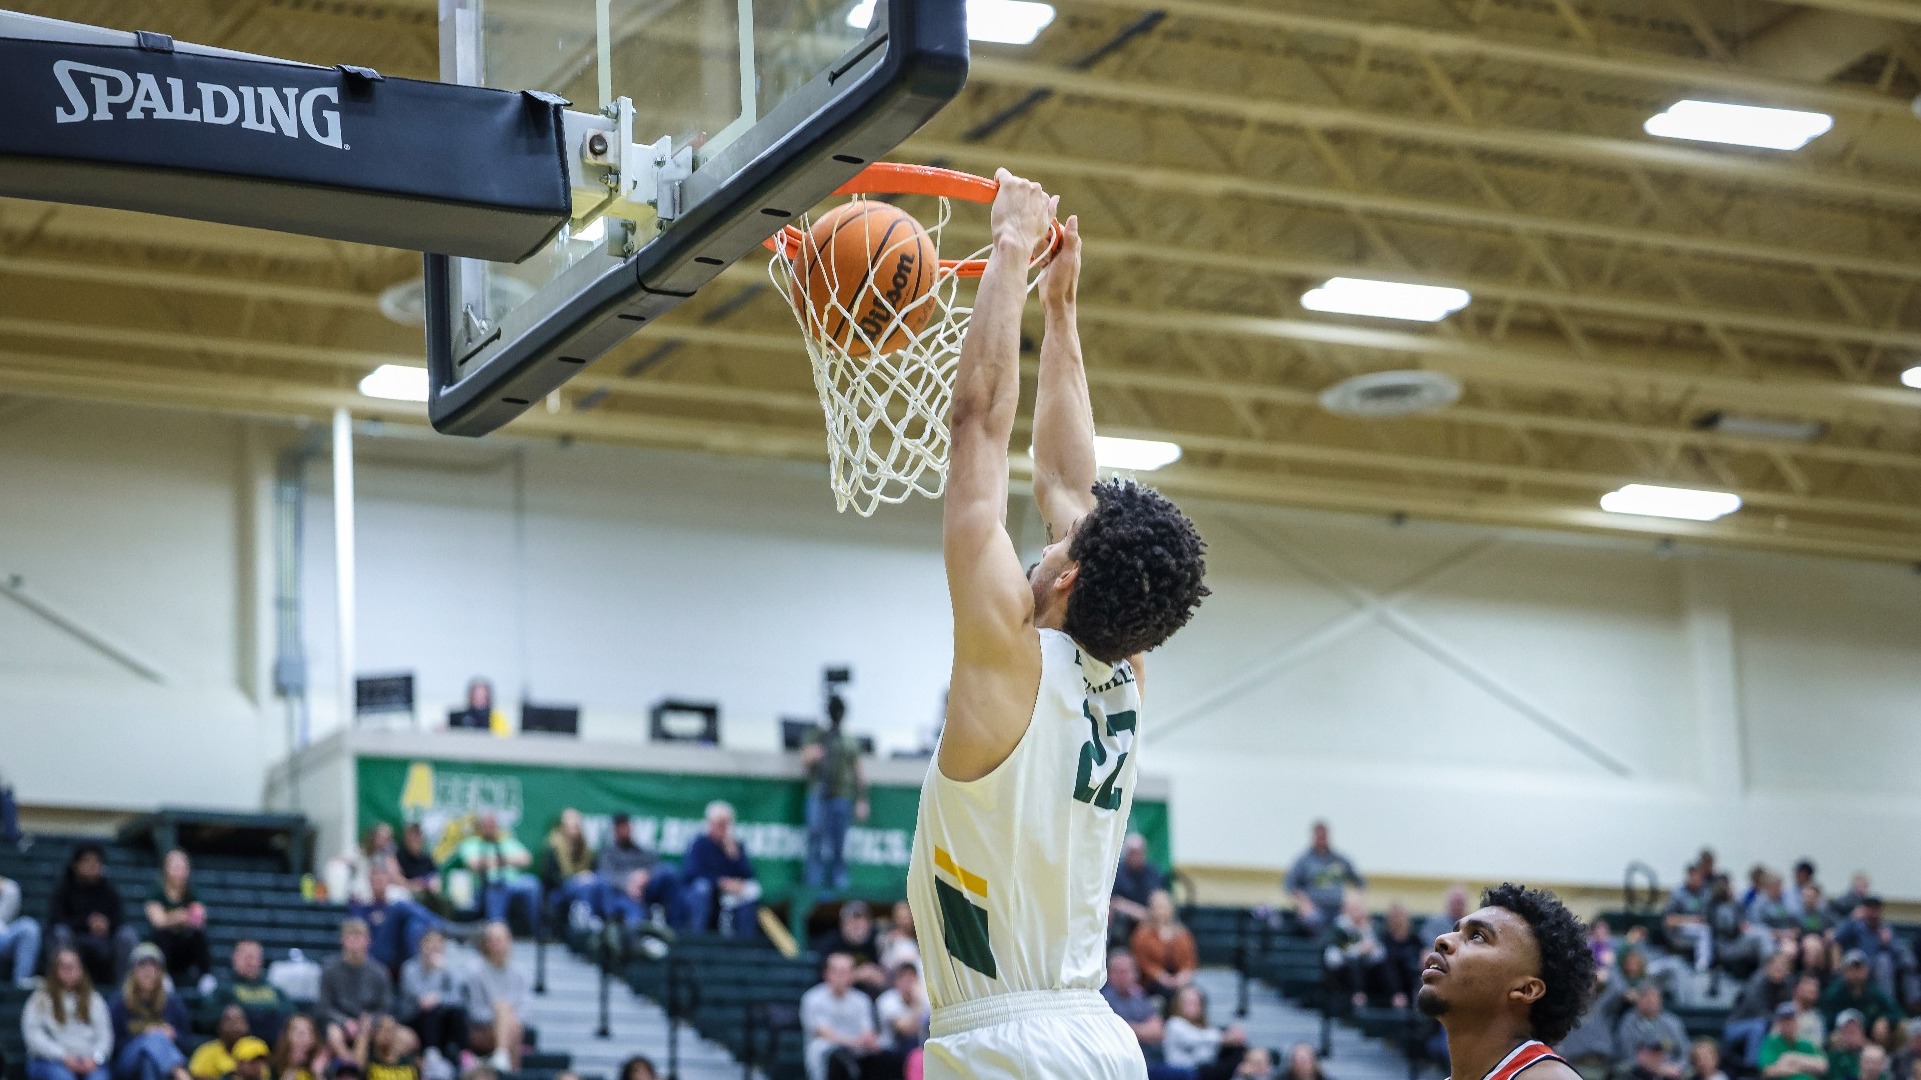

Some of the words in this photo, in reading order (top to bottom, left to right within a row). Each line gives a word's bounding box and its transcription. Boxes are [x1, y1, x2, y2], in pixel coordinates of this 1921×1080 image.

[52, 59, 343, 149] SPALDING
[853, 252, 916, 343] Wilson
[1073, 698, 1137, 811] 22
